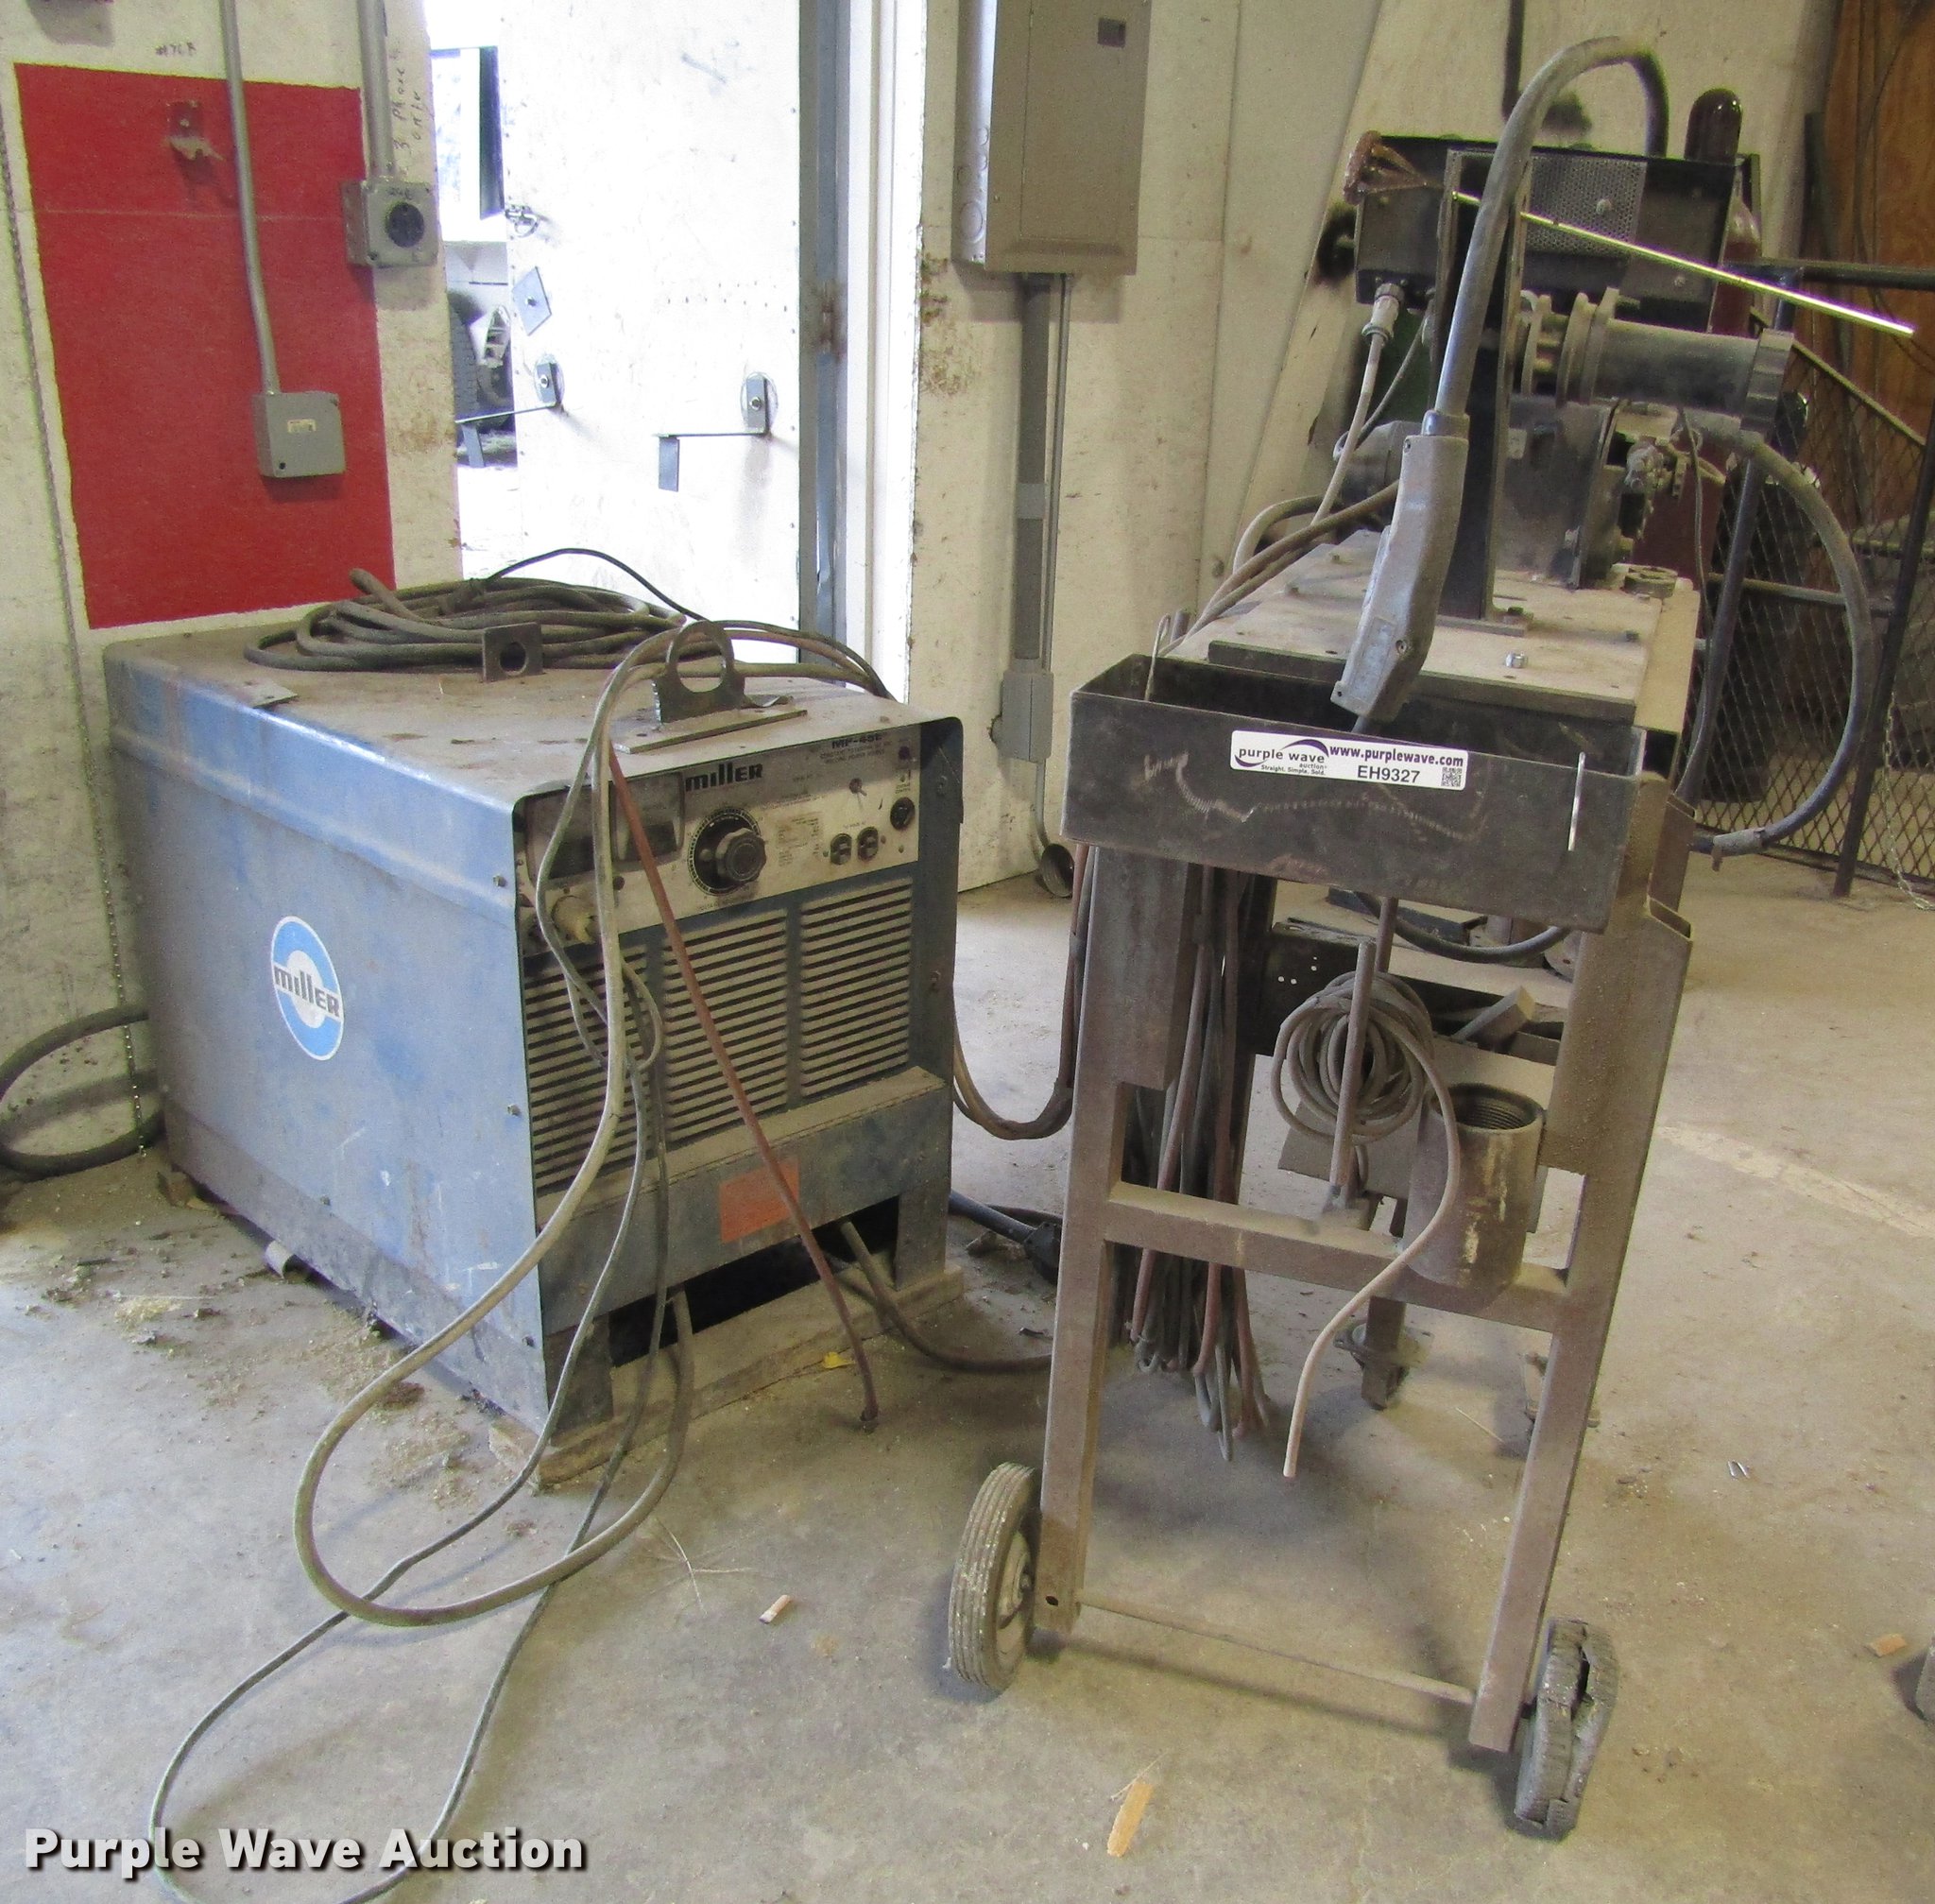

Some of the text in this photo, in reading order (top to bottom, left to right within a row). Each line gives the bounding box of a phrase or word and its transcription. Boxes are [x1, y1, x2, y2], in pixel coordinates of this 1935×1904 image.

[1239, 748, 1325, 763] purple wave
[1329, 746, 1464, 766] www.purplewave.com
[1260, 763, 1286, 773] Straight.
[1288, 766, 1310, 775] Simple.
[1357, 765, 1421, 783] EH9327
